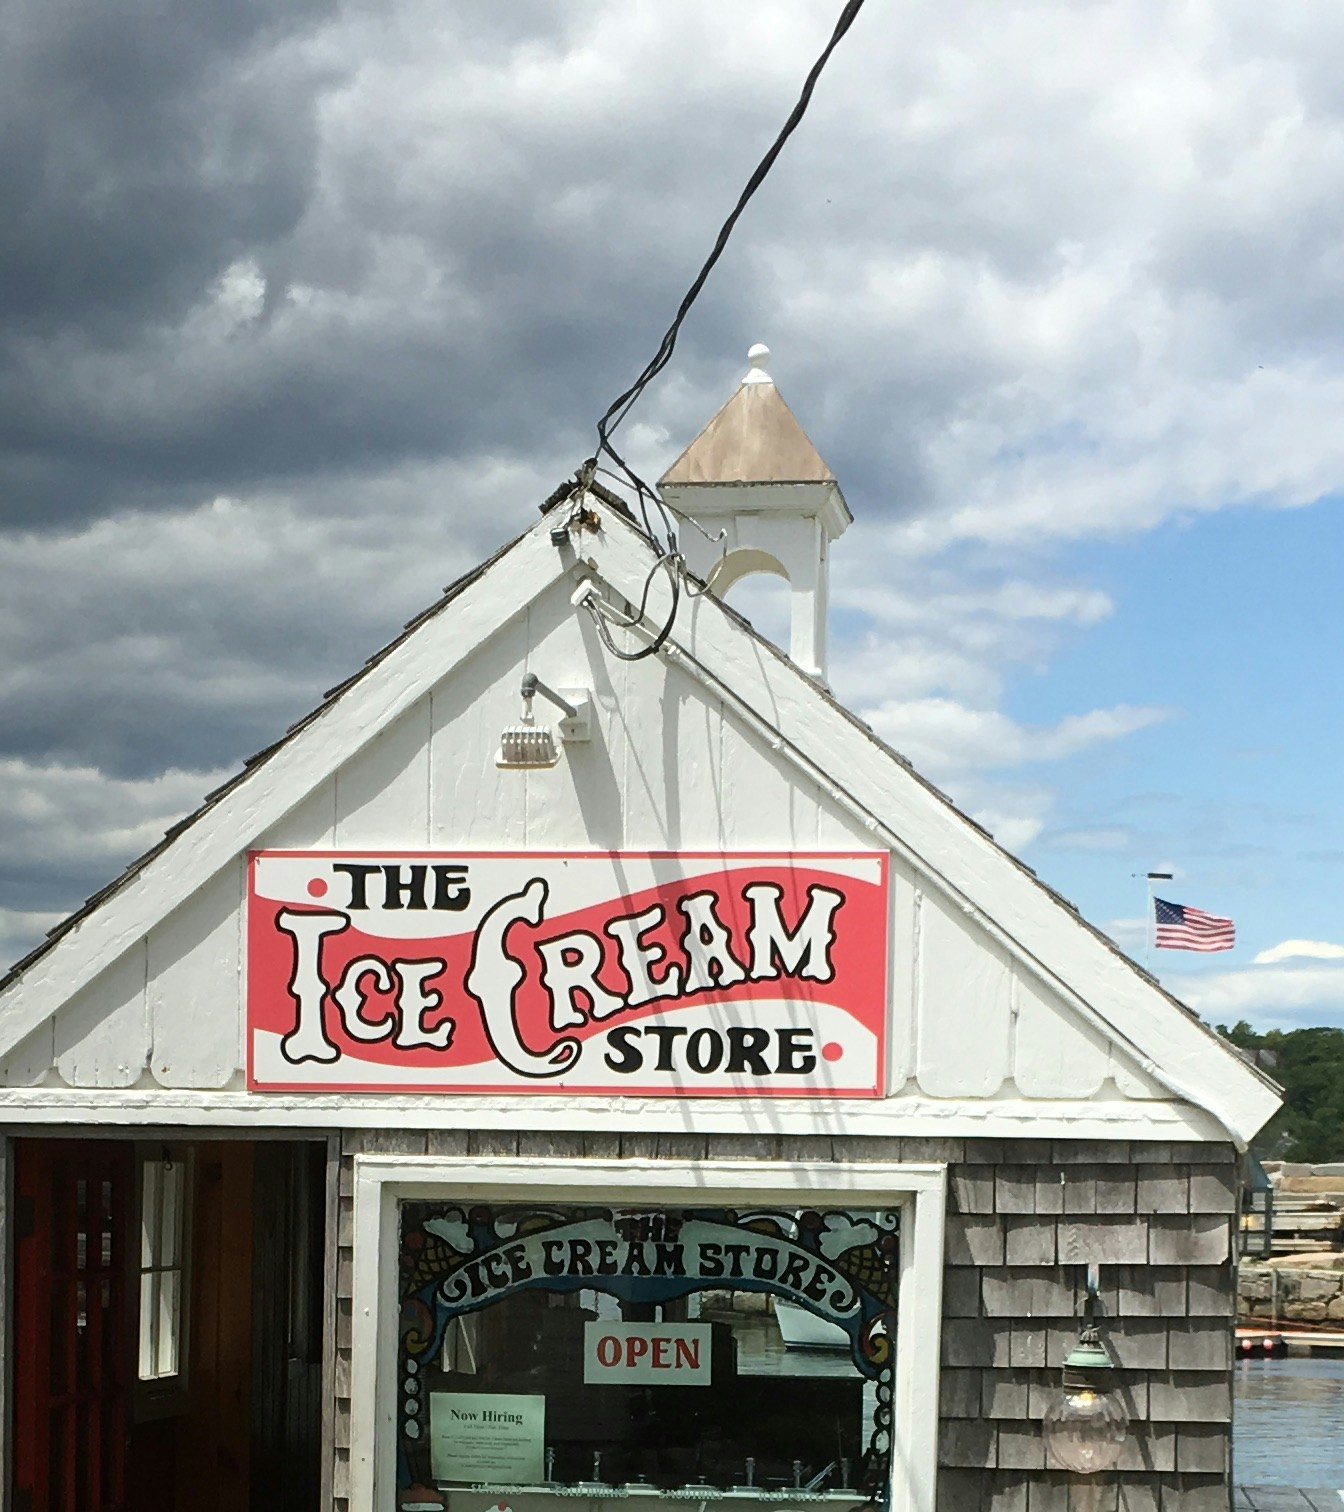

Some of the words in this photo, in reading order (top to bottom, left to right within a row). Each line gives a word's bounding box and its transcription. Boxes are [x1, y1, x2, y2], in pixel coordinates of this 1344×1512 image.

[333, 863, 472, 911] THE
[604, 1026, 816, 1076] STORE
[463, 1245, 533, 1297] ICE
[542, 1240, 684, 1277] CREAM
[698, 1243, 837, 1301] STORE
[597, 1336, 701, 1369] OPEN
[451, 1409, 478, 1420] Now
[483, 1411, 523, 1425] Hiring
